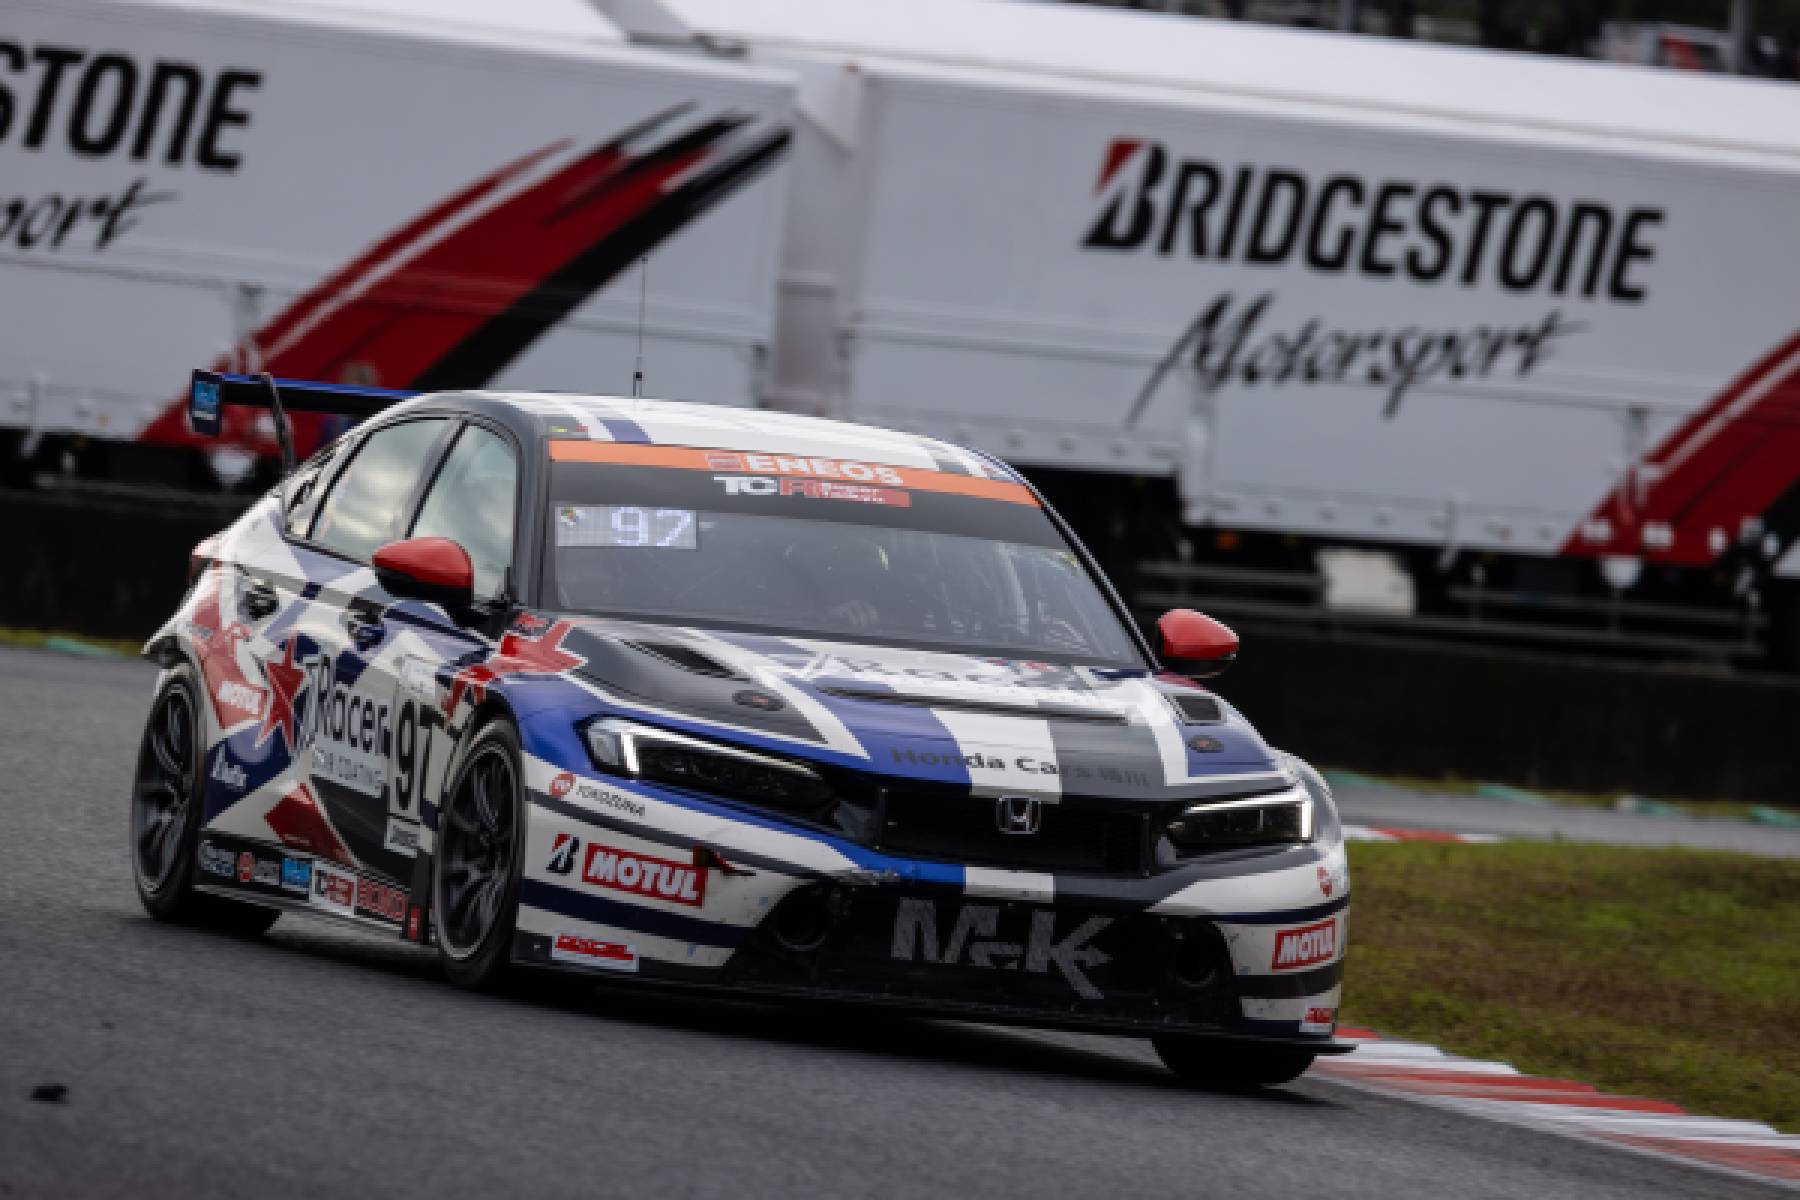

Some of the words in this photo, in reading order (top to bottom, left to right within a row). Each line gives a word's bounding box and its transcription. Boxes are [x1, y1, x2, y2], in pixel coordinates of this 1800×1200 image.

[1082, 138, 1664, 304] BRIDGESTONE
[1122, 290, 1590, 432] Motorsport
[745, 454, 905, 485] ENEOS
[611, 506, 692, 547] 97
[889, 746, 1005, 770] Honda
[587, 850, 700, 902] MOTUL
